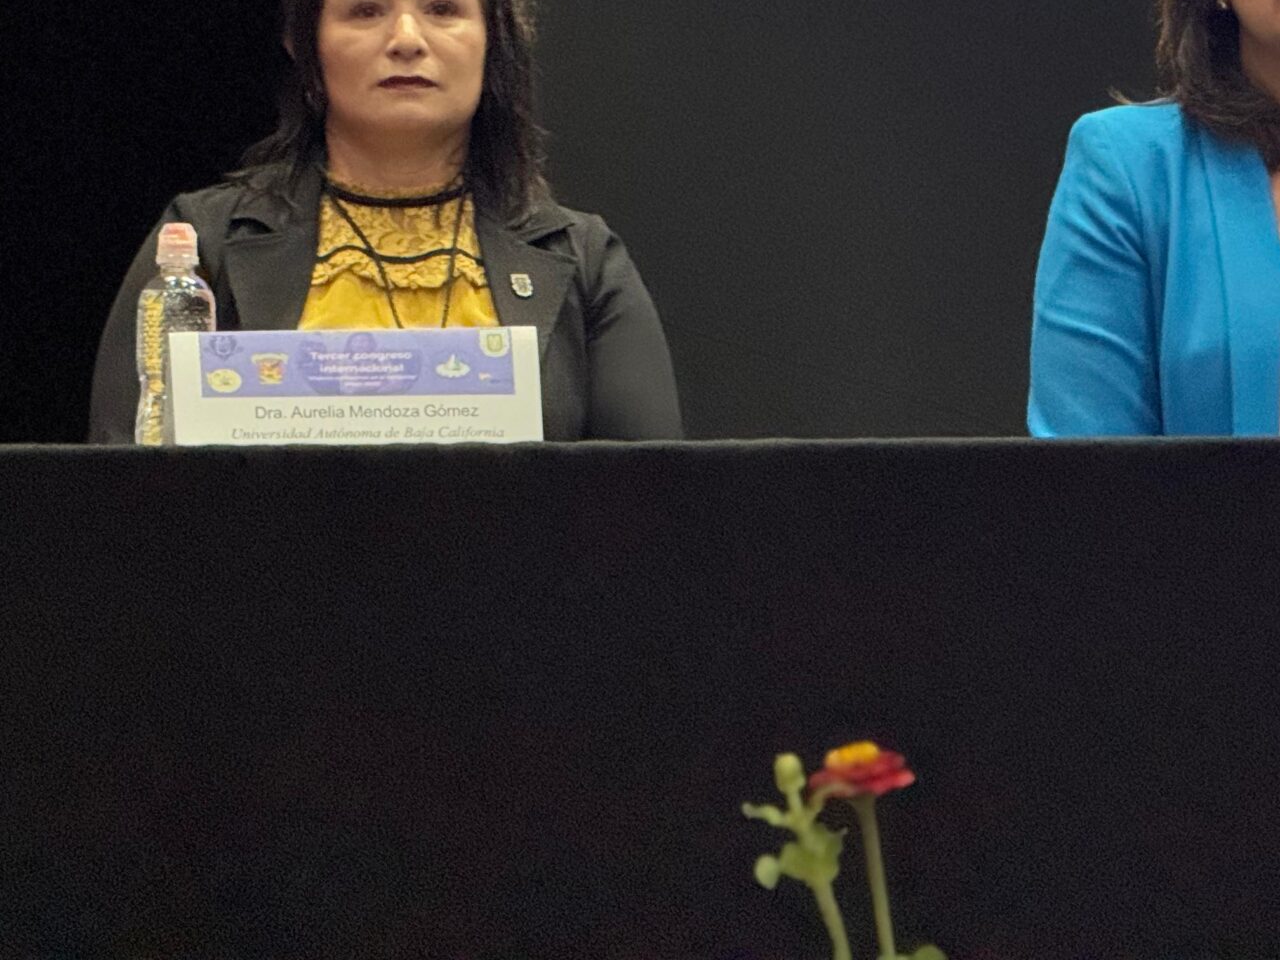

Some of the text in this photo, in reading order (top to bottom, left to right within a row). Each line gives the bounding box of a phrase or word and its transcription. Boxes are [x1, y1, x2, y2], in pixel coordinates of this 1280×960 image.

[352, 352, 412, 362] congreso
[255, 403, 479, 419] Dra. Aurelia Mendoza Gómez
[231, 426, 505, 440] Universidad Autónoma de Baja California
